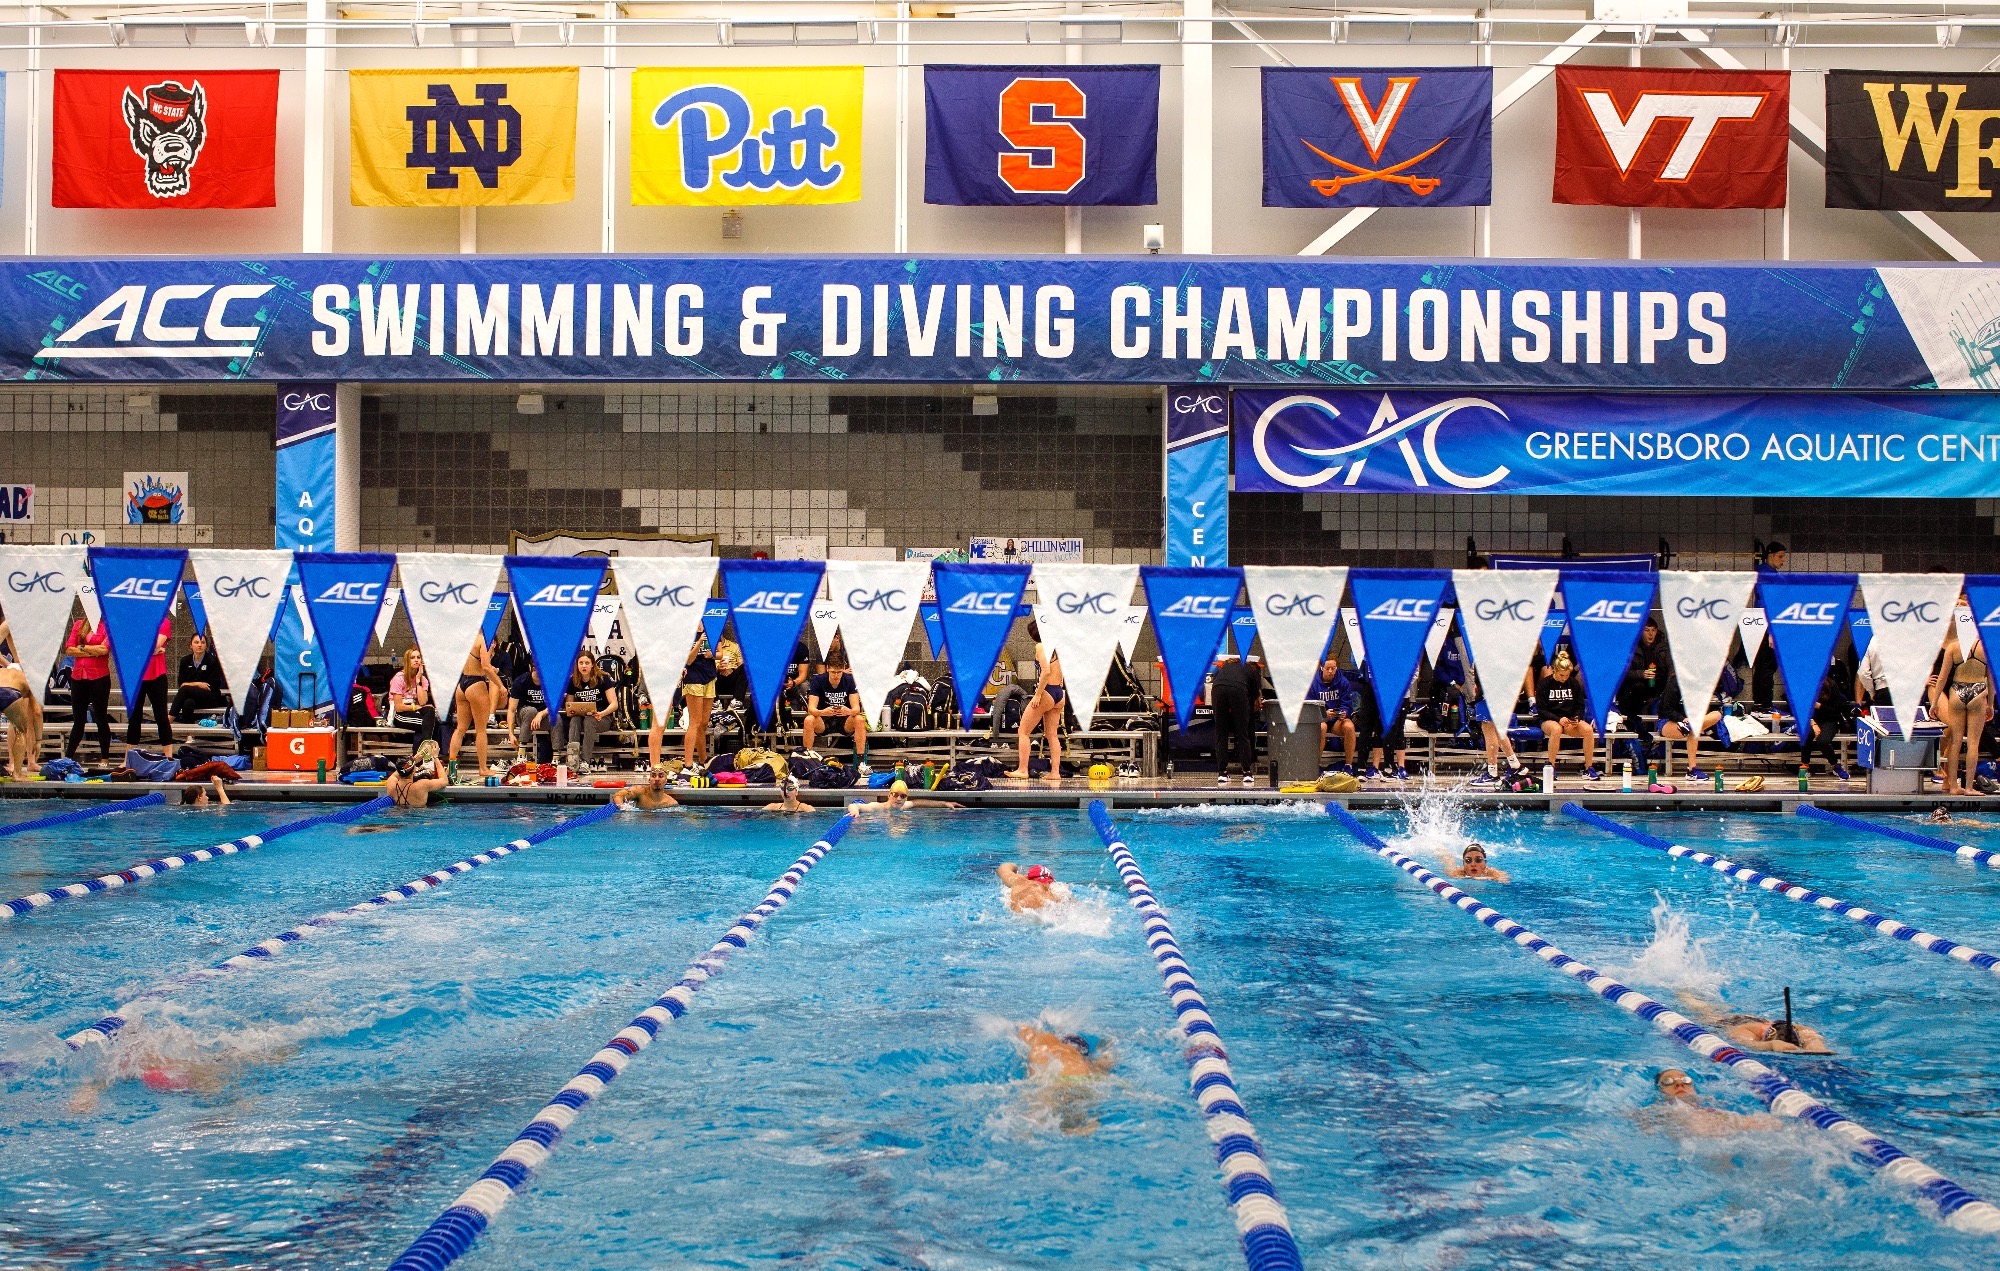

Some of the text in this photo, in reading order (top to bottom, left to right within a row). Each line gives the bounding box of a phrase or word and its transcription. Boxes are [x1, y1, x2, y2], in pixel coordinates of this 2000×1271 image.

[152, 102, 185, 118] NC STATE
[652, 84, 844, 193] Pitt
[998, 77, 1087, 195] S
[1576, 87, 1769, 183] VT
[24, 268, 90, 302] ACC
[54, 284, 276, 342] ACC
[311, 283, 705, 357] SWIMMING
[739, 285, 787, 357] &
[822, 284, 1075, 358] DIVING
[1110, 285, 1727, 365] CHAMPIONSHIPS
[283, 393, 331, 411] GAC
[1174, 395, 1224, 414] GAC
[1252, 393, 2000, 488] GAC GREENSBORO AQUATIC CENT
[970, 544, 987, 559] ME
[7, 571, 66, 594] GAC
[104, 577, 173, 601] ACC
[213, 575, 271, 599] GAC
[313, 582, 383, 605] ACC
[419, 581, 478, 605] GAC
[524, 584, 594, 607] ACC
[634, 584, 695, 607] GAC
[733, 591, 803, 615] ACC
[847, 588, 907, 612] GAC
[945, 592, 1016, 615] ACC
[1056, 592, 1117, 614] GAC
[1159, 595, 1231, 619] ACC
[1266, 594, 1326, 617] GAC
[815, 610, 837, 619] GAC
[1364, 598, 1436, 622] ACC
[1475, 598, 1535, 622] GAC
[1575, 599, 1646, 623] ACC
[1676, 596, 1731, 619] GAC
[1771, 602, 1840, 625] ACC
[1881, 601, 1940, 623] GAC
[1742, 616, 1764, 626] GAC
[1319, 690, 1340, 702] DUKE
[1548, 688, 1573, 699] DUKE
[289, 737, 305, 755] G
[1857, 728, 1871, 747] GAC
[1867, 750, 1873, 765] 4
